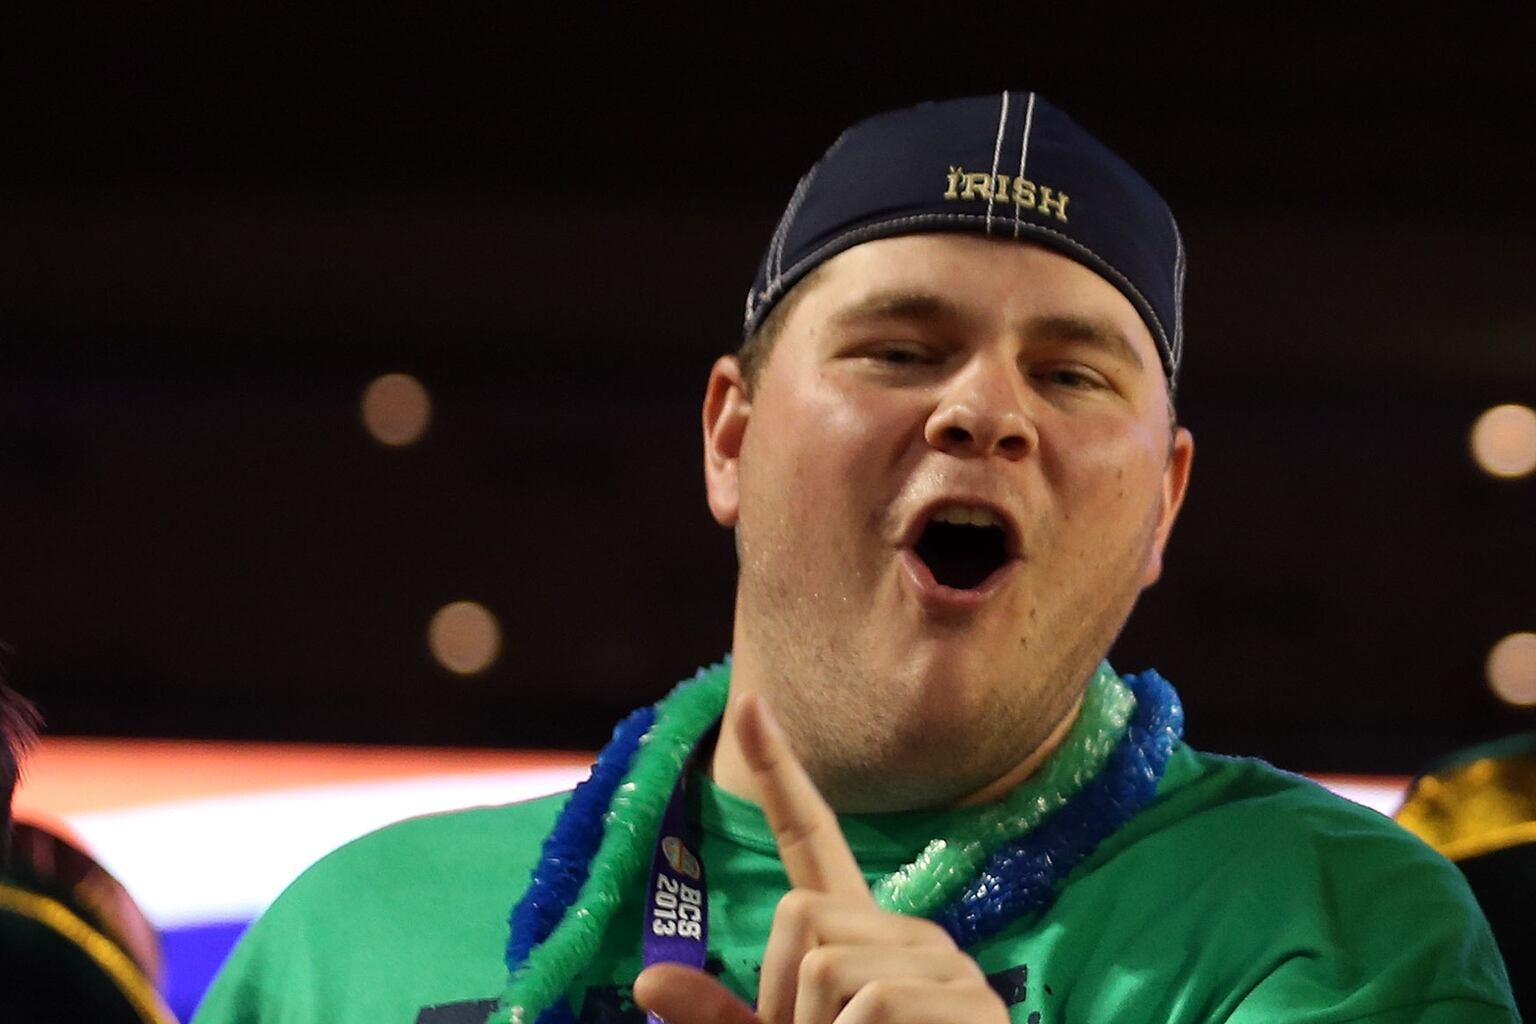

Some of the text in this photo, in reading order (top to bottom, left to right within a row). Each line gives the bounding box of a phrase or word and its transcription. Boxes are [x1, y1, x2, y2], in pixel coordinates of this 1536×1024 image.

[943, 166, 1071, 223] IRISH
[652, 872, 679, 937] 2013
[678, 882, 702, 941] BCS
